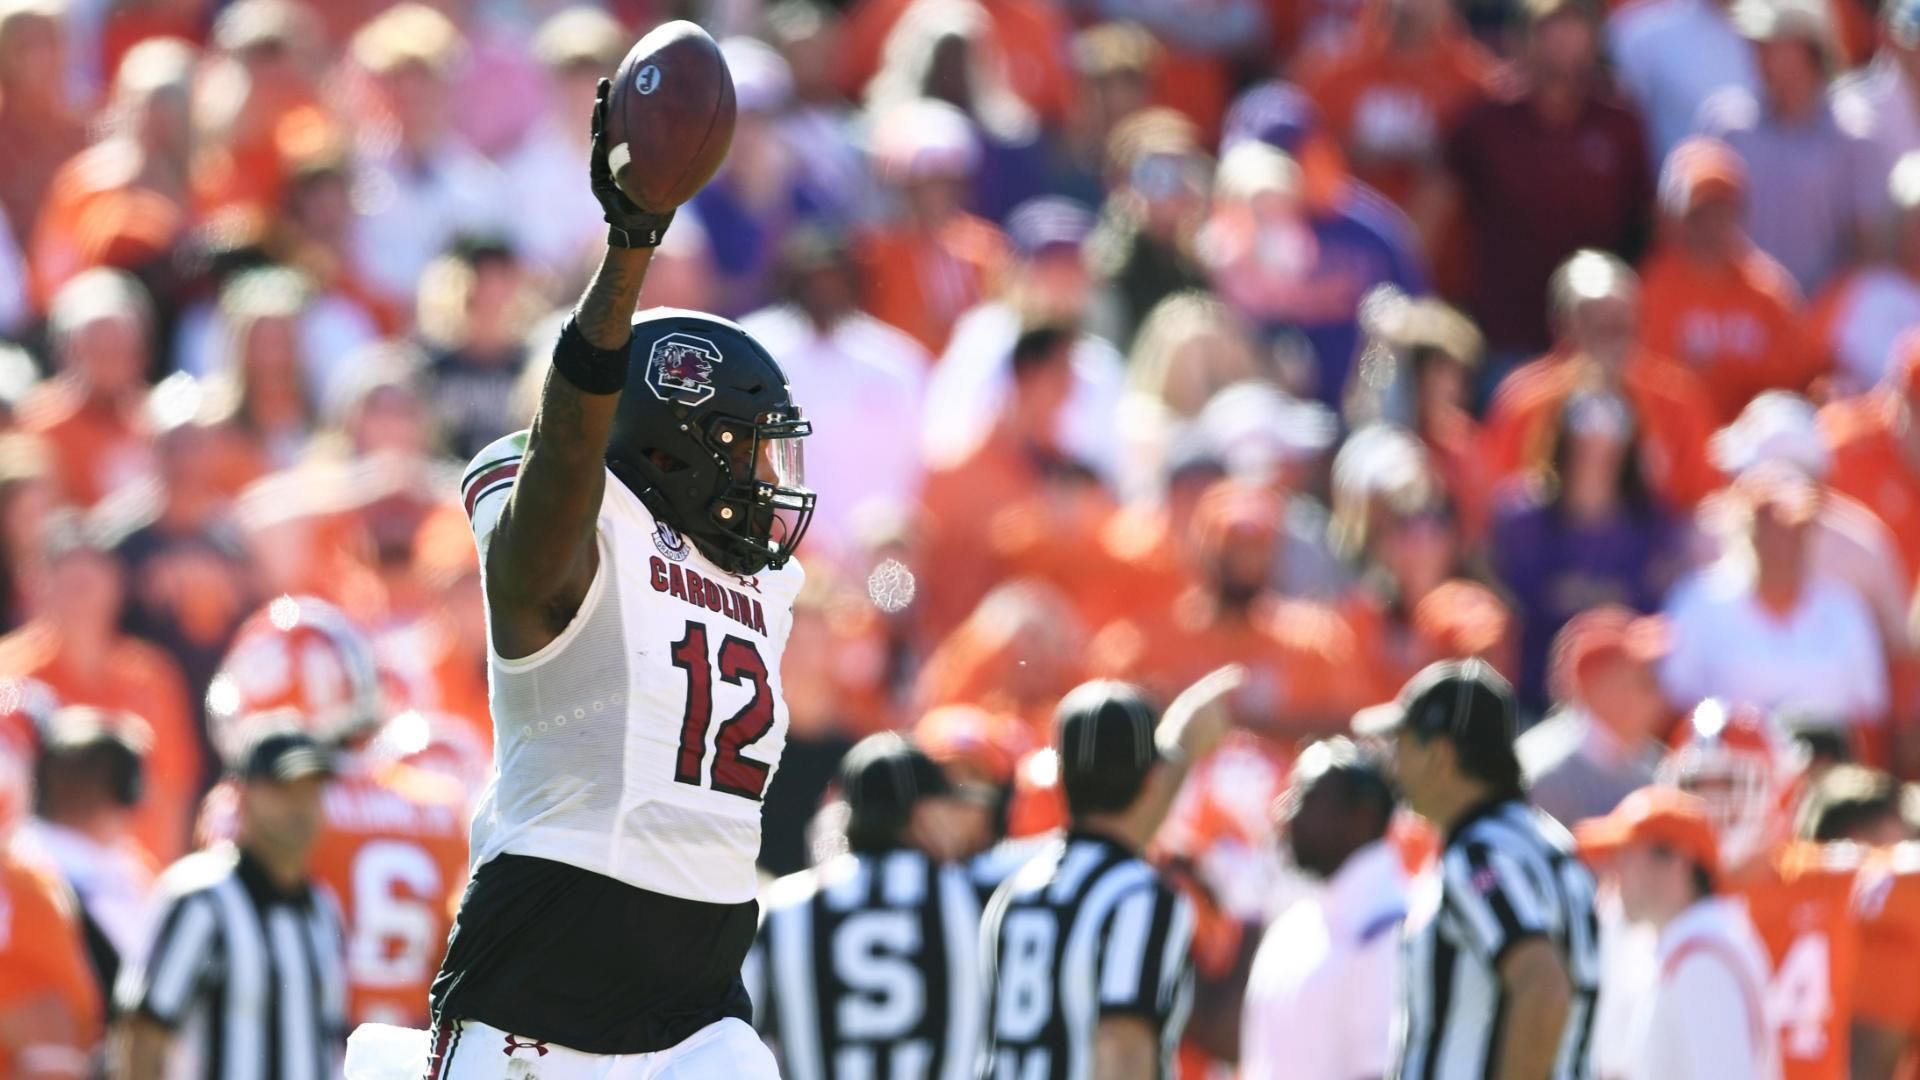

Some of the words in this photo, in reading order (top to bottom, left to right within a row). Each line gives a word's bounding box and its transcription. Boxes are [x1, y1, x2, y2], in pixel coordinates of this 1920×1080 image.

[649, 555, 768, 638] CAROLINA
[670, 619, 775, 802] 12
[351, 838, 441, 987] 6
[833, 910, 926, 1040] S
